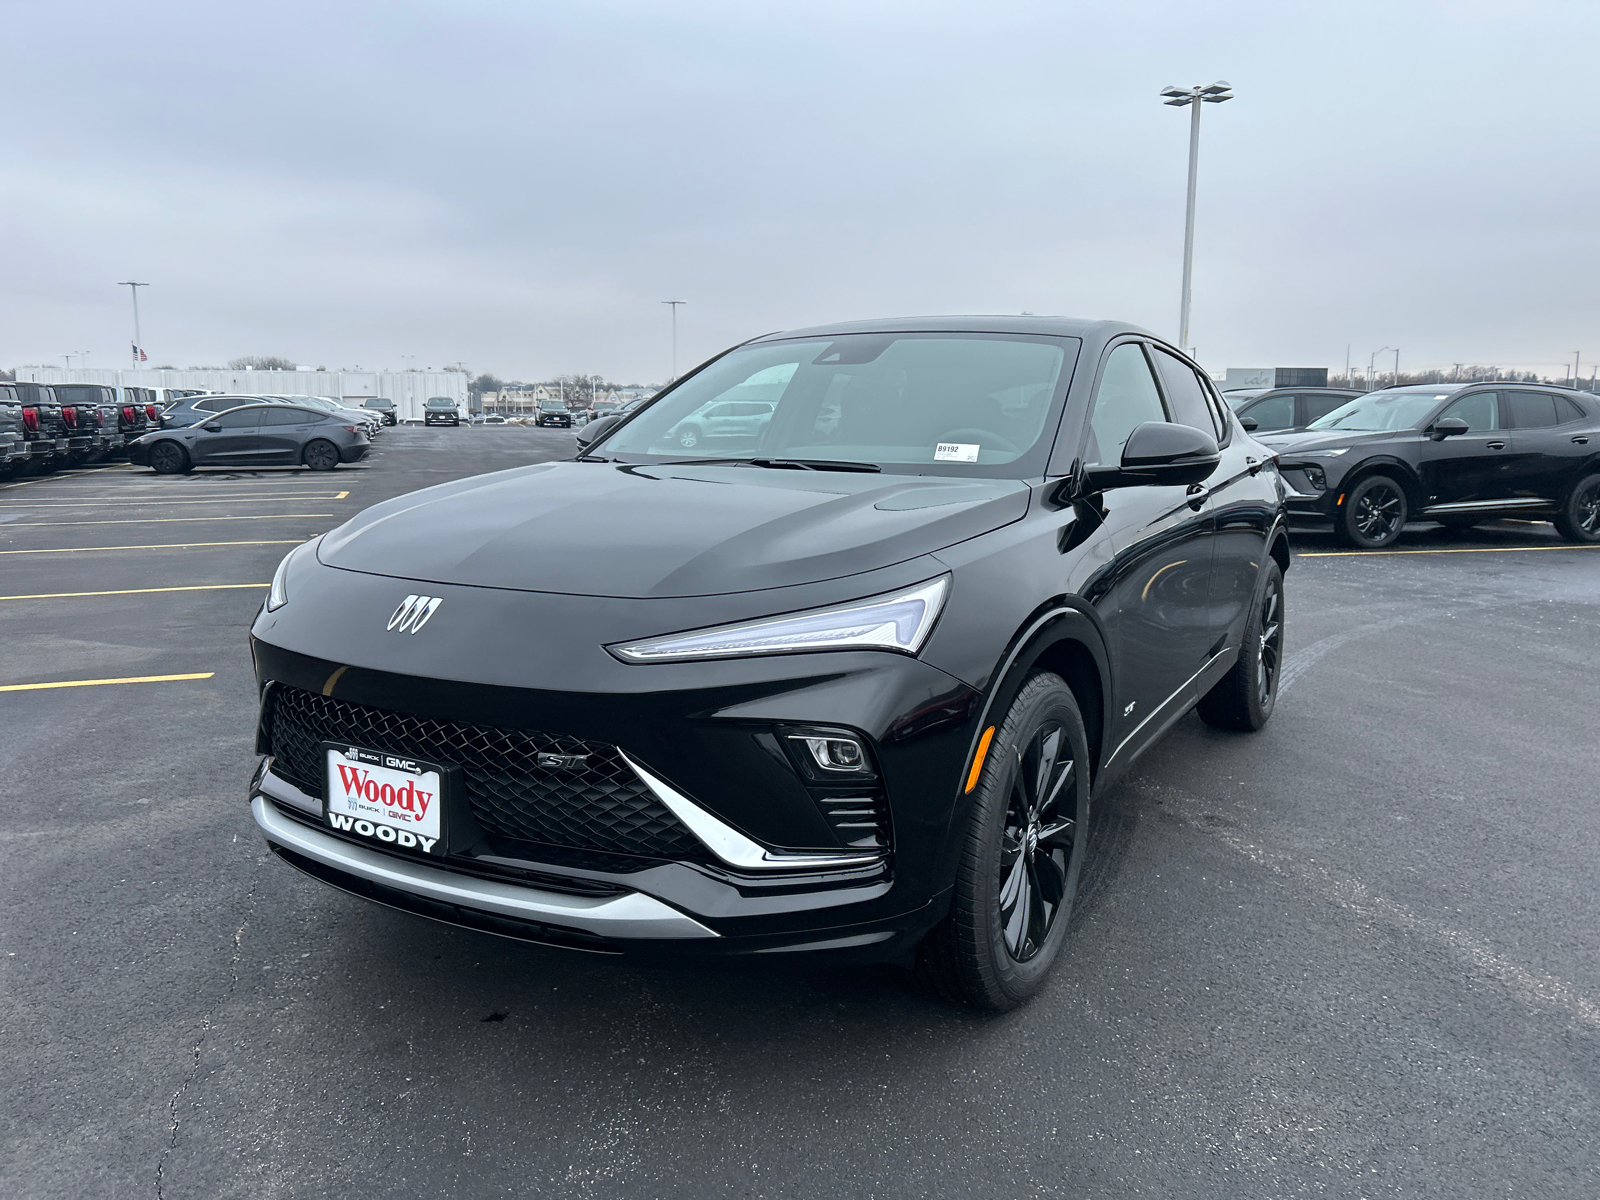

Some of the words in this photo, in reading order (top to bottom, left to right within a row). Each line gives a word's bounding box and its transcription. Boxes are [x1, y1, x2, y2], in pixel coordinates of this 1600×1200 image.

[938, 445, 958, 453] B9192
[360, 753, 380, 761] BUICK
[386, 757, 416, 771] GMC
[540, 754, 586, 768] ST
[336, 763, 433, 822] Woody
[359, 804, 380, 813] BUICK
[388, 810, 412, 822] GMC
[328, 812, 438, 853] WOODY
